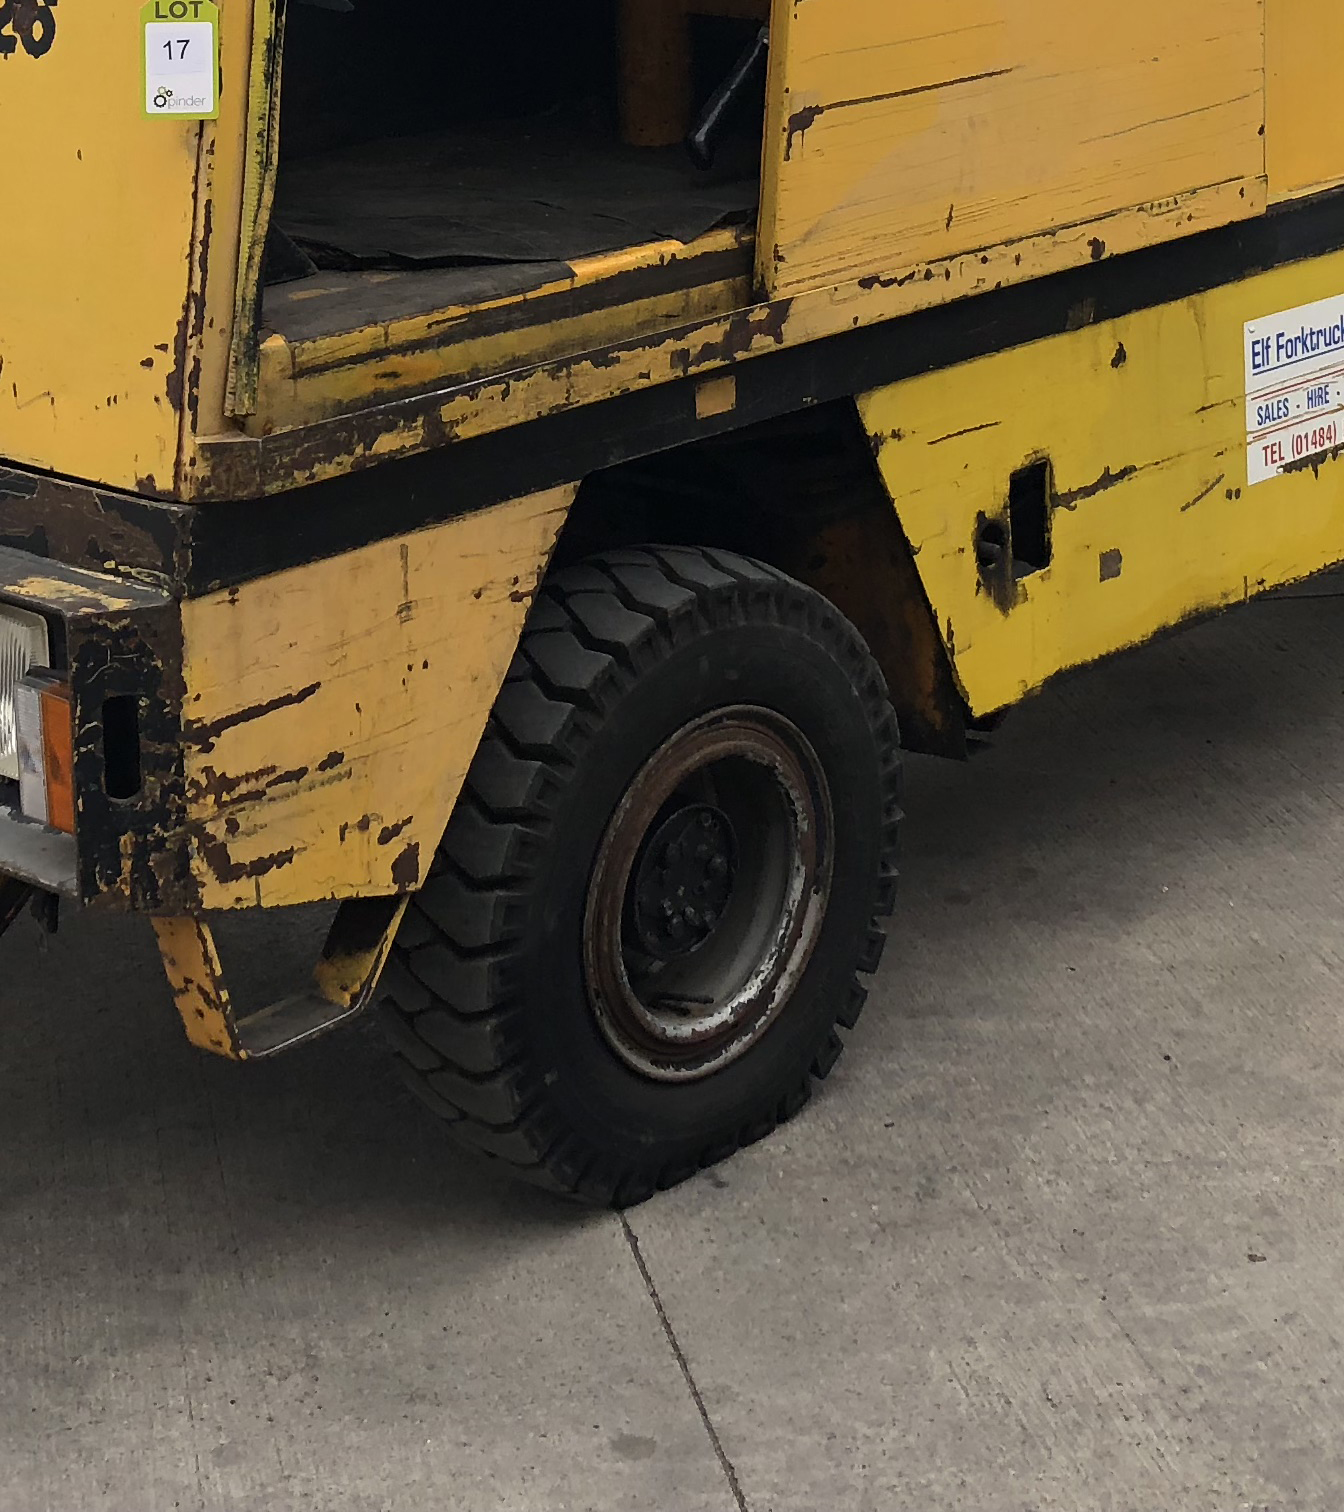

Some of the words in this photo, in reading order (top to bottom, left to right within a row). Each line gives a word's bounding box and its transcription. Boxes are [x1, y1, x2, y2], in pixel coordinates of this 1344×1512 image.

[155, 0, 204, 19] LOT
[163, 39, 190, 60] 17
[167, 95, 206, 108] pinder
[1251, 335, 1271, 370] Elf
[1256, 397, 1290, 426] SALES
[1306, 384, 1330, 410] HIRE
[1262, 440, 1285, 467] TEL
[1291, 420, 1337, 459] (01484)
